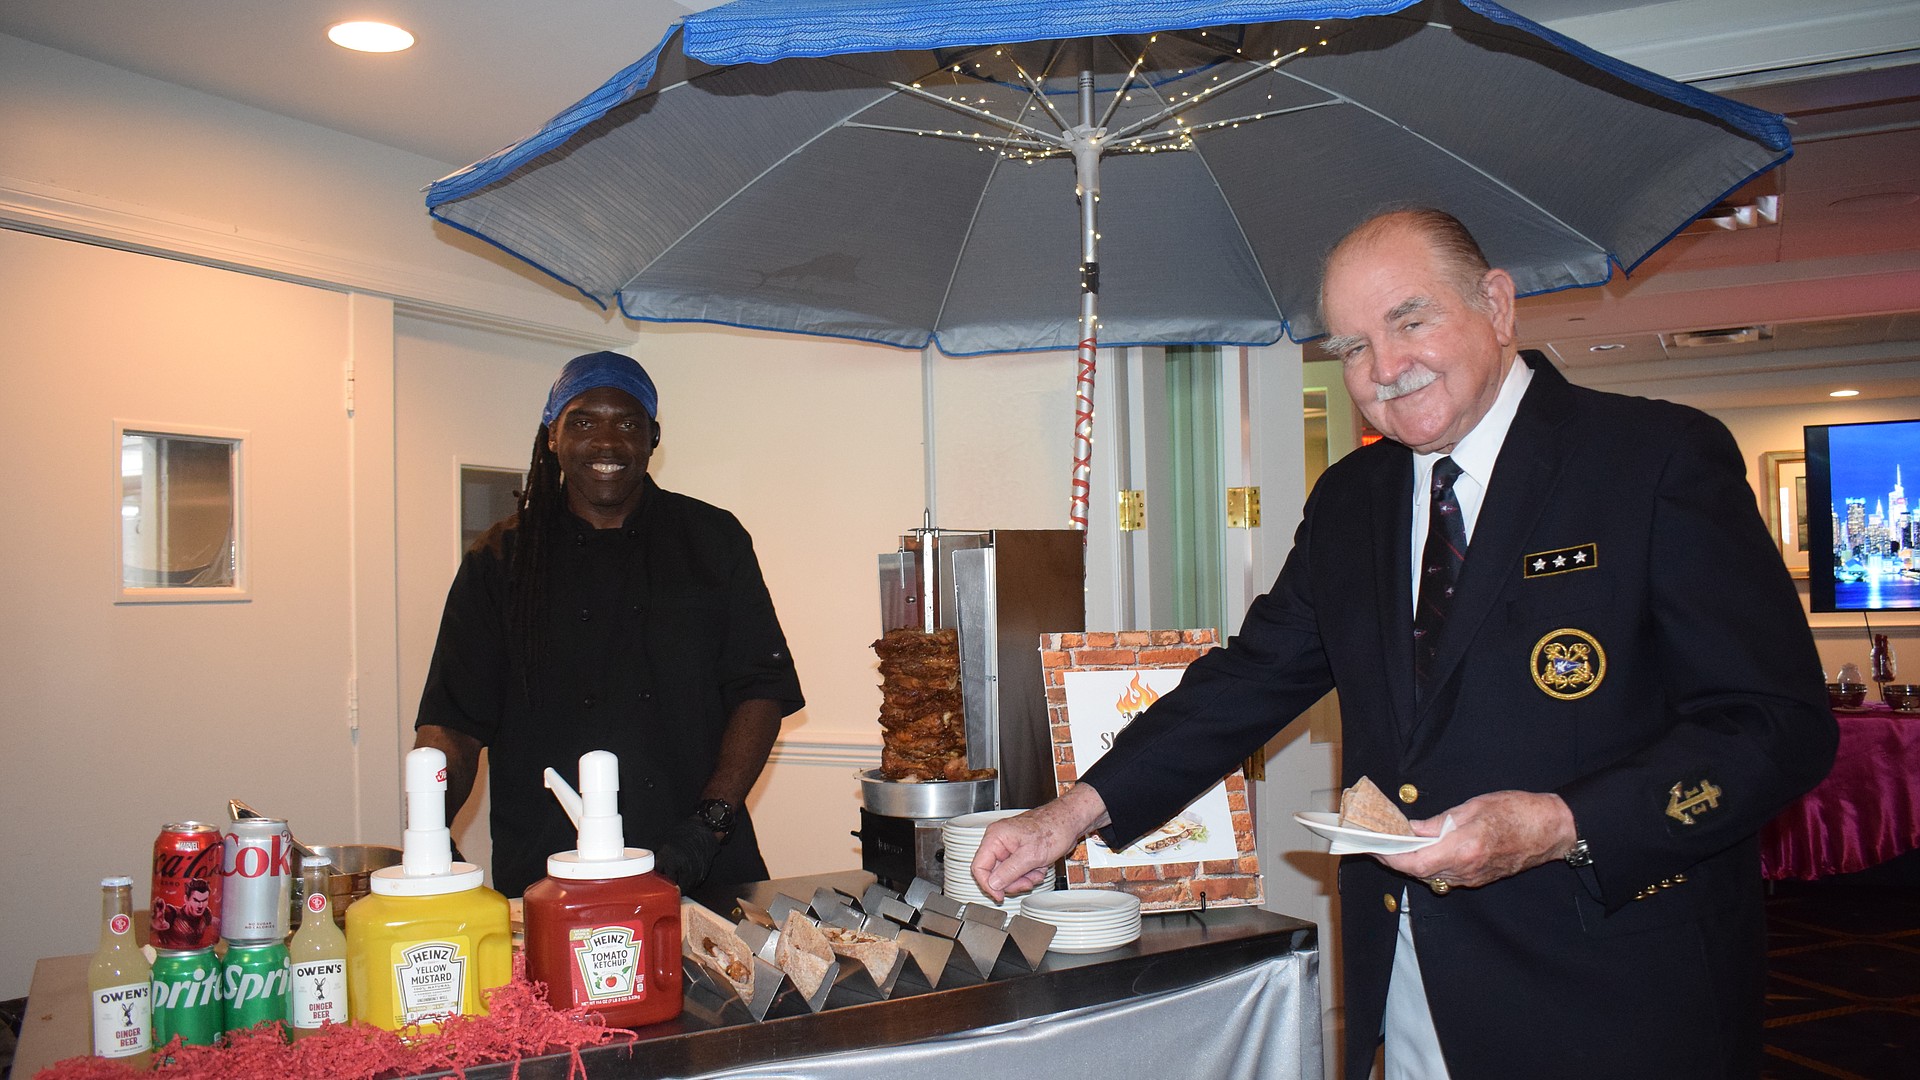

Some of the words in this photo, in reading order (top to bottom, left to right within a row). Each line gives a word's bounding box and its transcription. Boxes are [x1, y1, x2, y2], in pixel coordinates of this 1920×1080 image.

[221, 833, 292, 878] Cok
[593, 935, 624, 947] HEINZ
[413, 950, 449, 963] HEINZ
[591, 950, 628, 963] TOMATO
[297, 964, 342, 977] OWEN'S
[415, 964, 447, 975] YELLOW
[594, 959, 627, 969] KETCHUP
[223, 956, 292, 1009] Spri
[411, 972, 452, 985] MUSTARD
[100, 987, 148, 1004] OWEN'S
[150, 967, 222, 1015] prite
[309, 1001, 333, 1011] GINGER
[313, 1010, 330, 1019] BEER
[115, 1027, 141, 1039] GINGER
[120, 1036, 138, 1047] BEER
